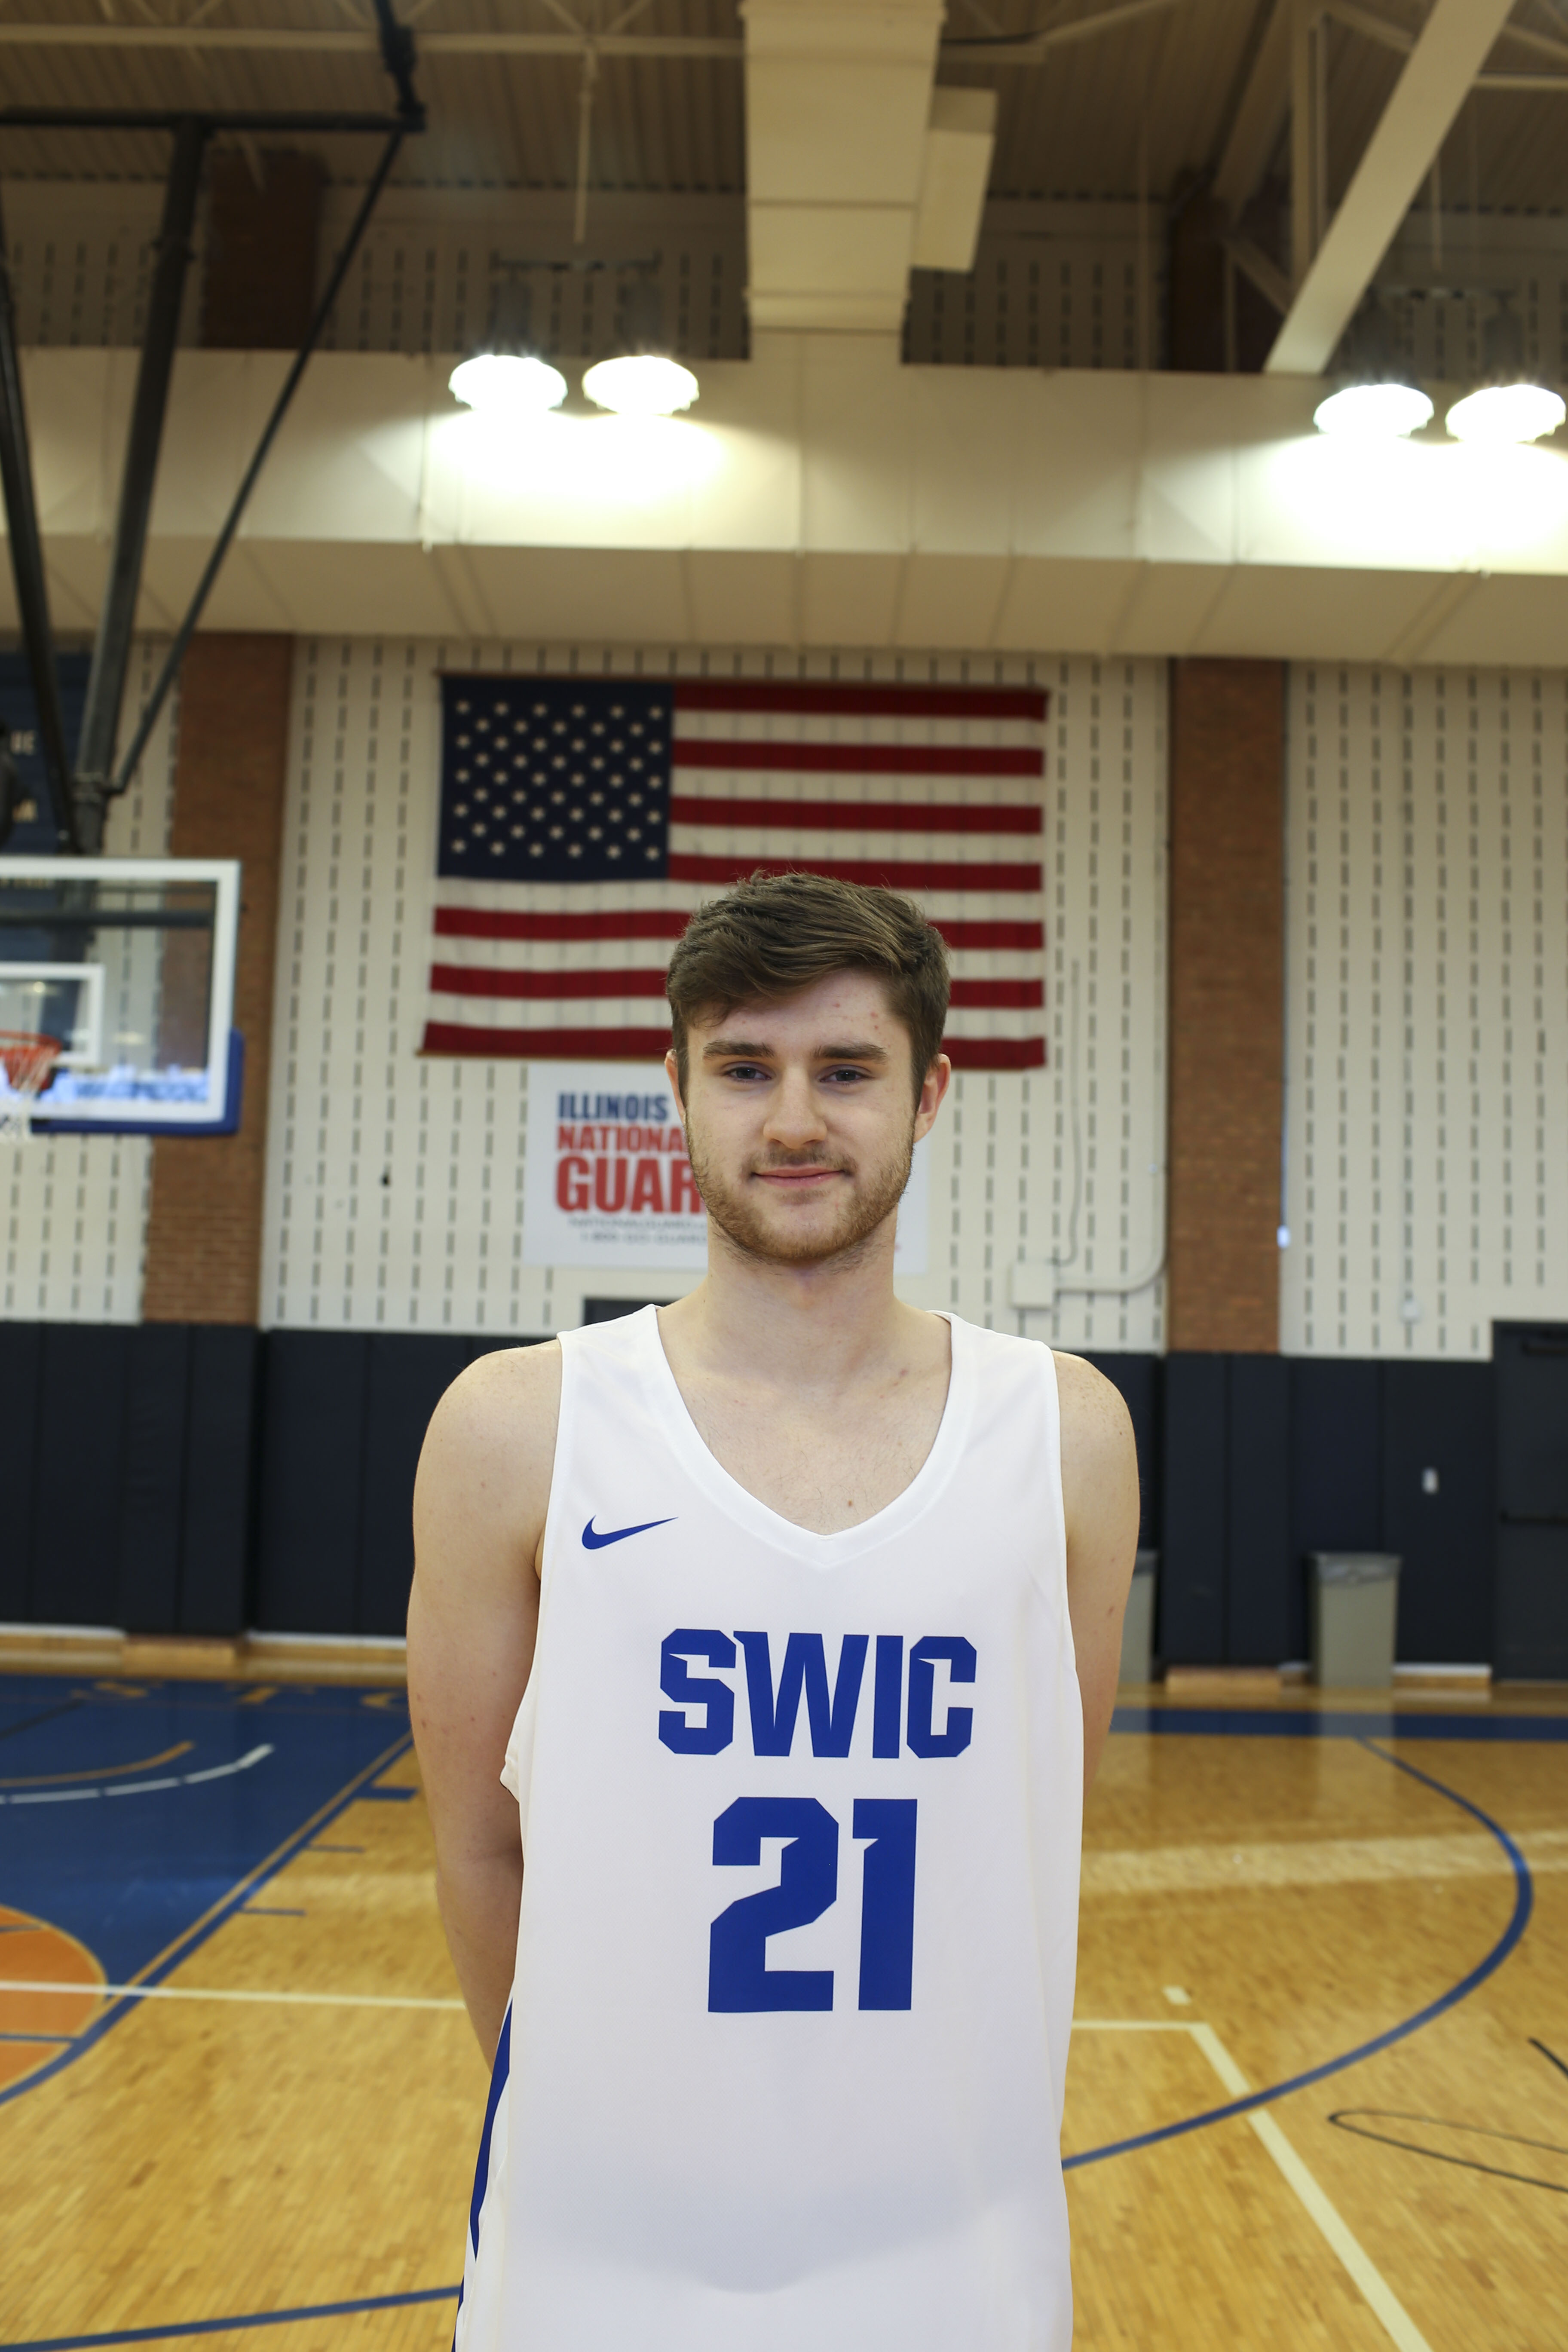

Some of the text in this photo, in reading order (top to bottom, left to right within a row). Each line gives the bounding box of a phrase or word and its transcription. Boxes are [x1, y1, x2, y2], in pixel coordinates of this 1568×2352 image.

[558, 1094, 669, 1121] ILLINOIS
[557, 1124, 688, 1153] NATIONA
[557, 1156, 705, 1214] GUAR
[658, 1628, 977, 1759] SWIC
[708, 1797, 918, 2013] 21
